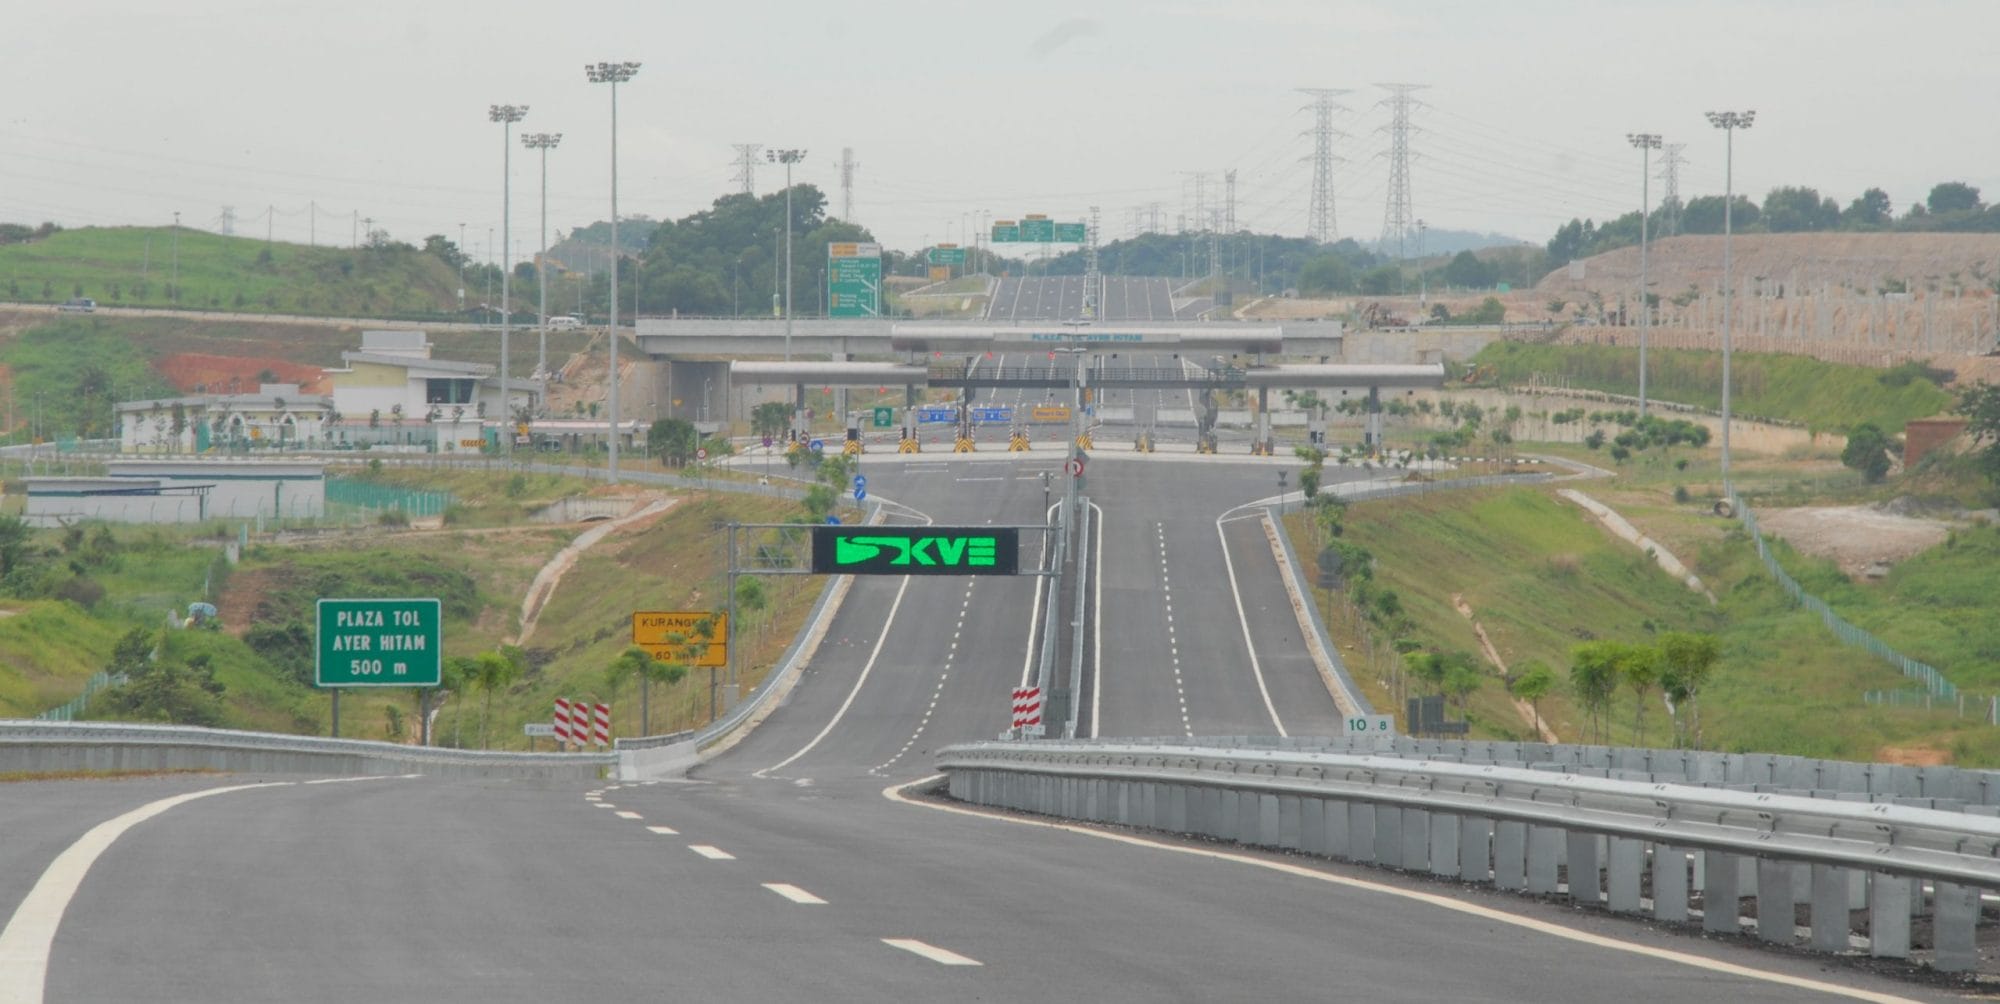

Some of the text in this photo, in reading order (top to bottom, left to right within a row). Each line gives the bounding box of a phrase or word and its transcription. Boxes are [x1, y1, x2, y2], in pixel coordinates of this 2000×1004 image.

[836, 536, 996, 566] SKVE
[337, 610, 420, 627] PLAZA TOL
[641, 617, 717, 628] KURANGK
[332, 634, 425, 651] AYER HITAM
[655, 650, 672, 661] 60
[350, 660, 407, 675] 500 m
